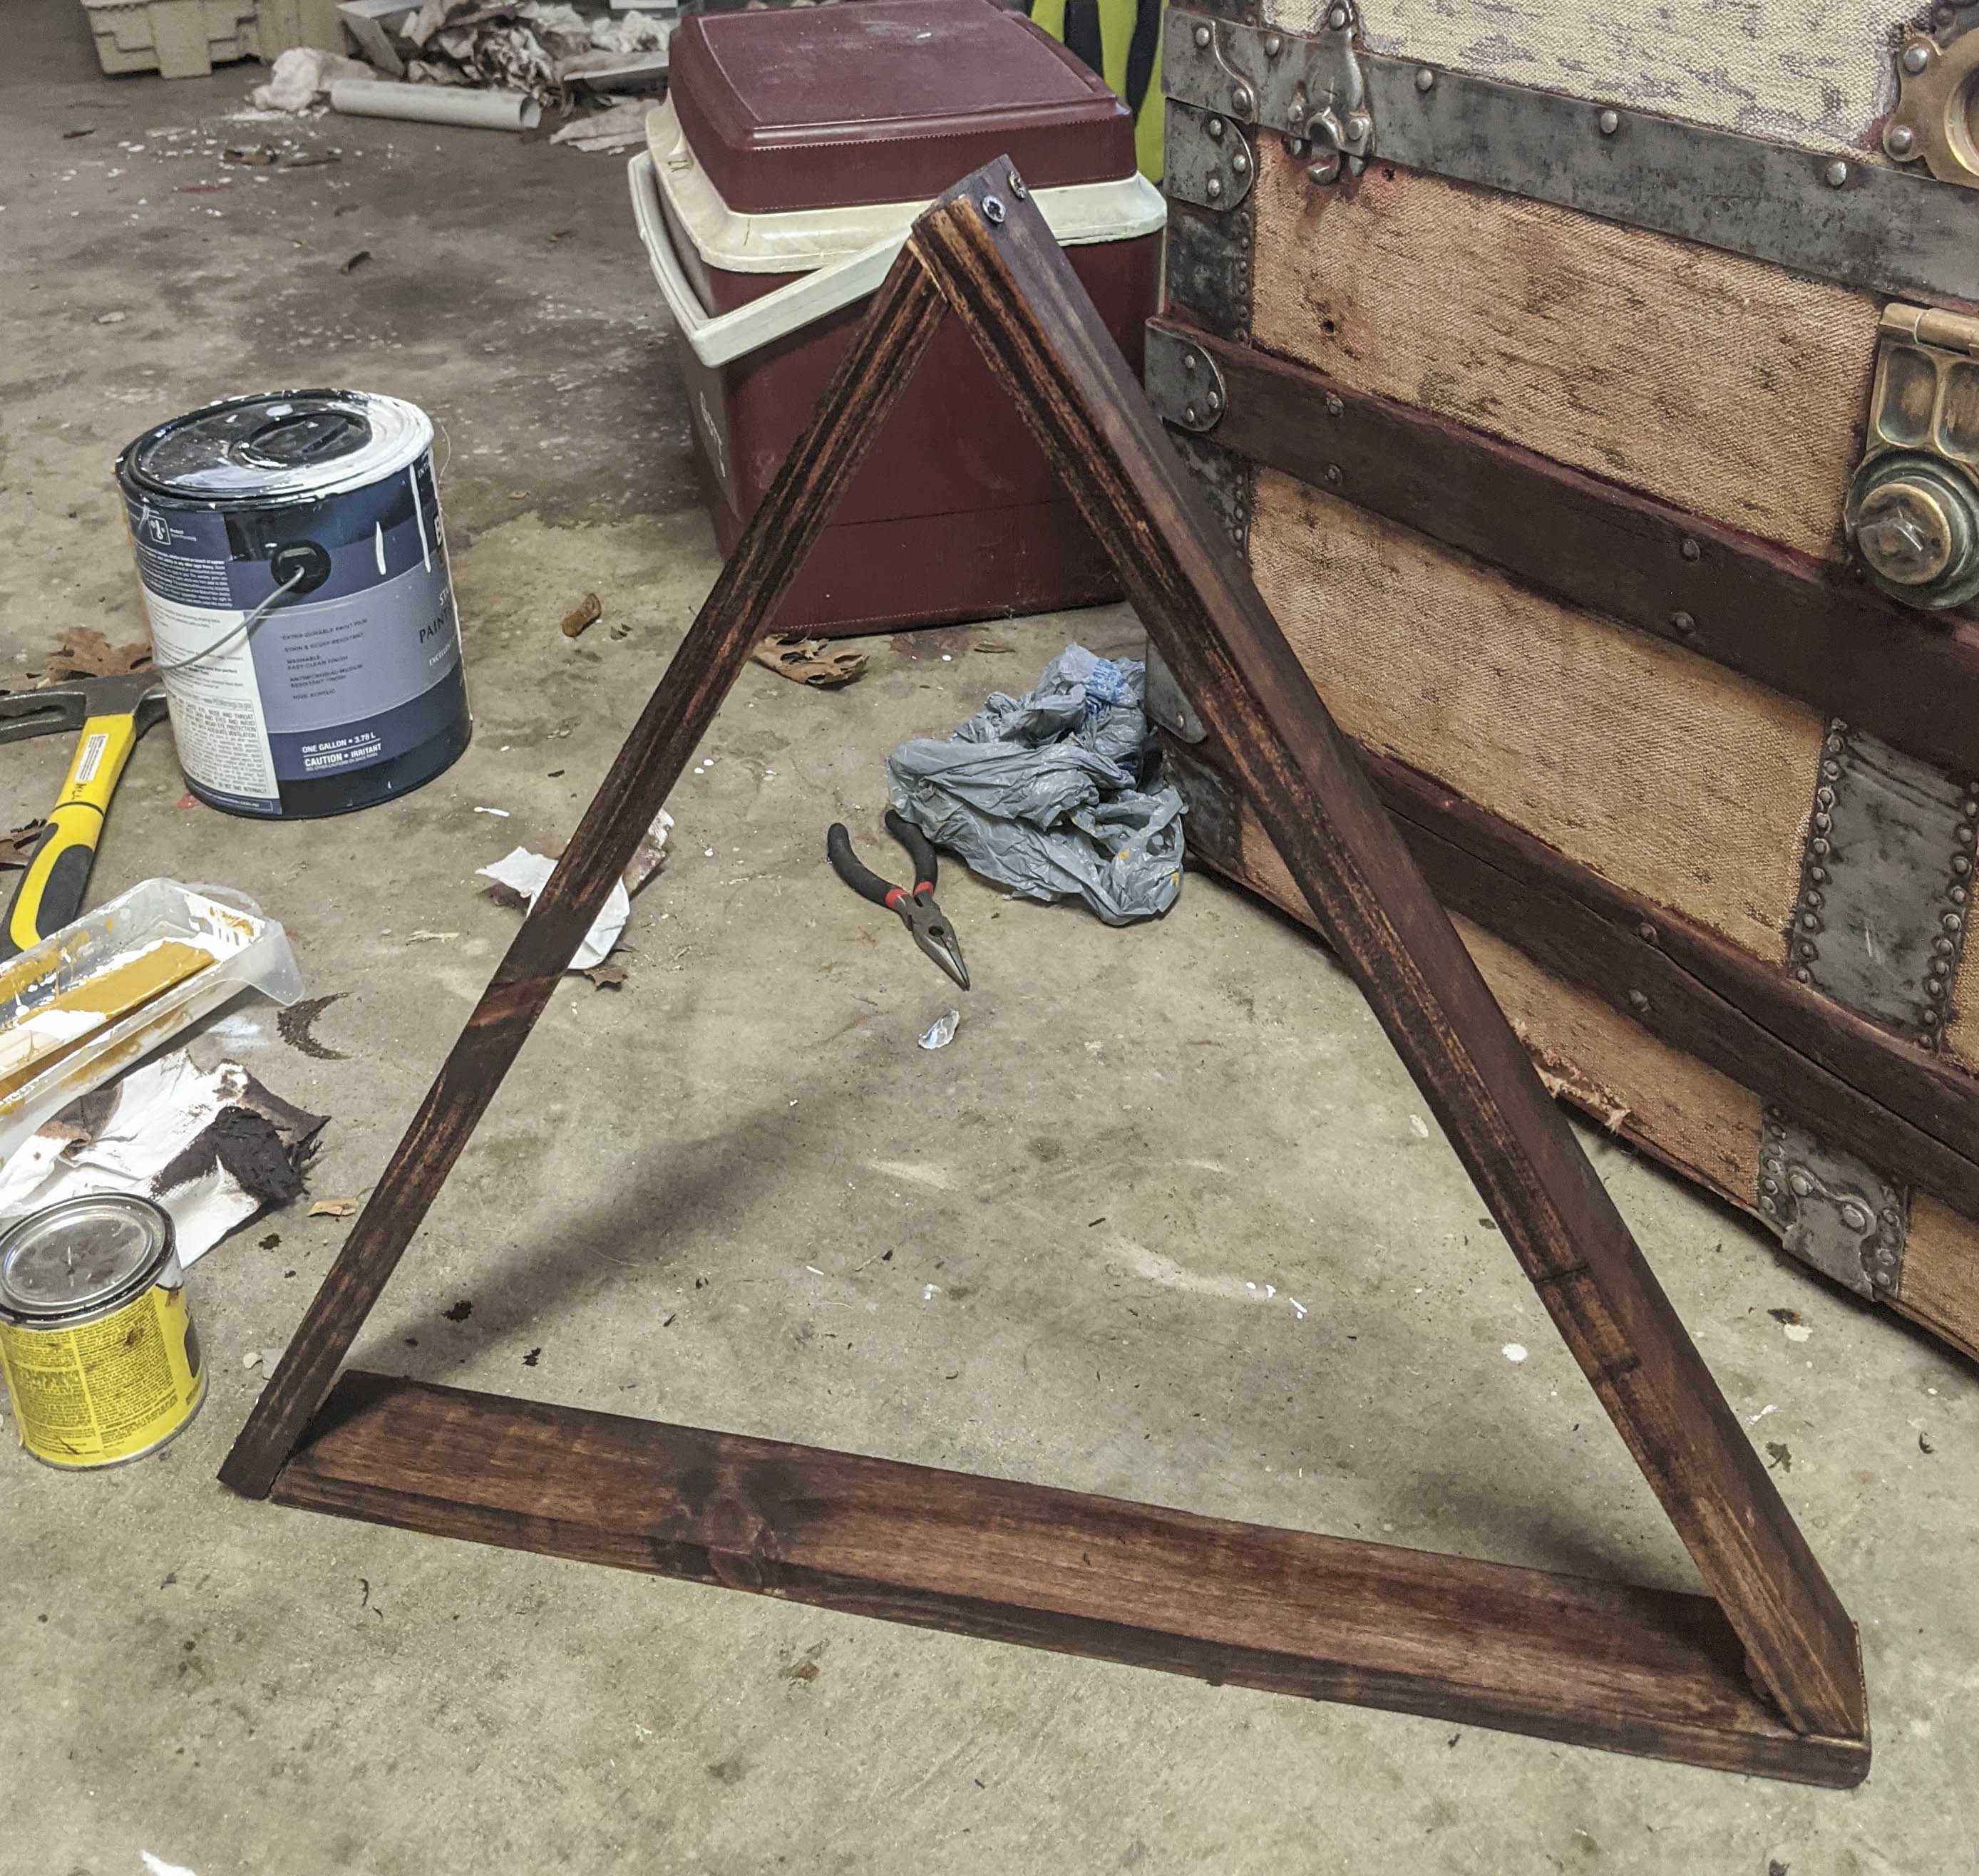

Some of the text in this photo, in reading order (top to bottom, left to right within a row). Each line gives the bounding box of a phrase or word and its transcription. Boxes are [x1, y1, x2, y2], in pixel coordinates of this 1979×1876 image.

[302, 745, 318, 753] ONE
[319, 739, 346, 751] GALLON
[354, 733, 370, 743] 3.78
[304, 753, 342, 767] CAUTION
[351, 743, 382, 758] IRRITANT
